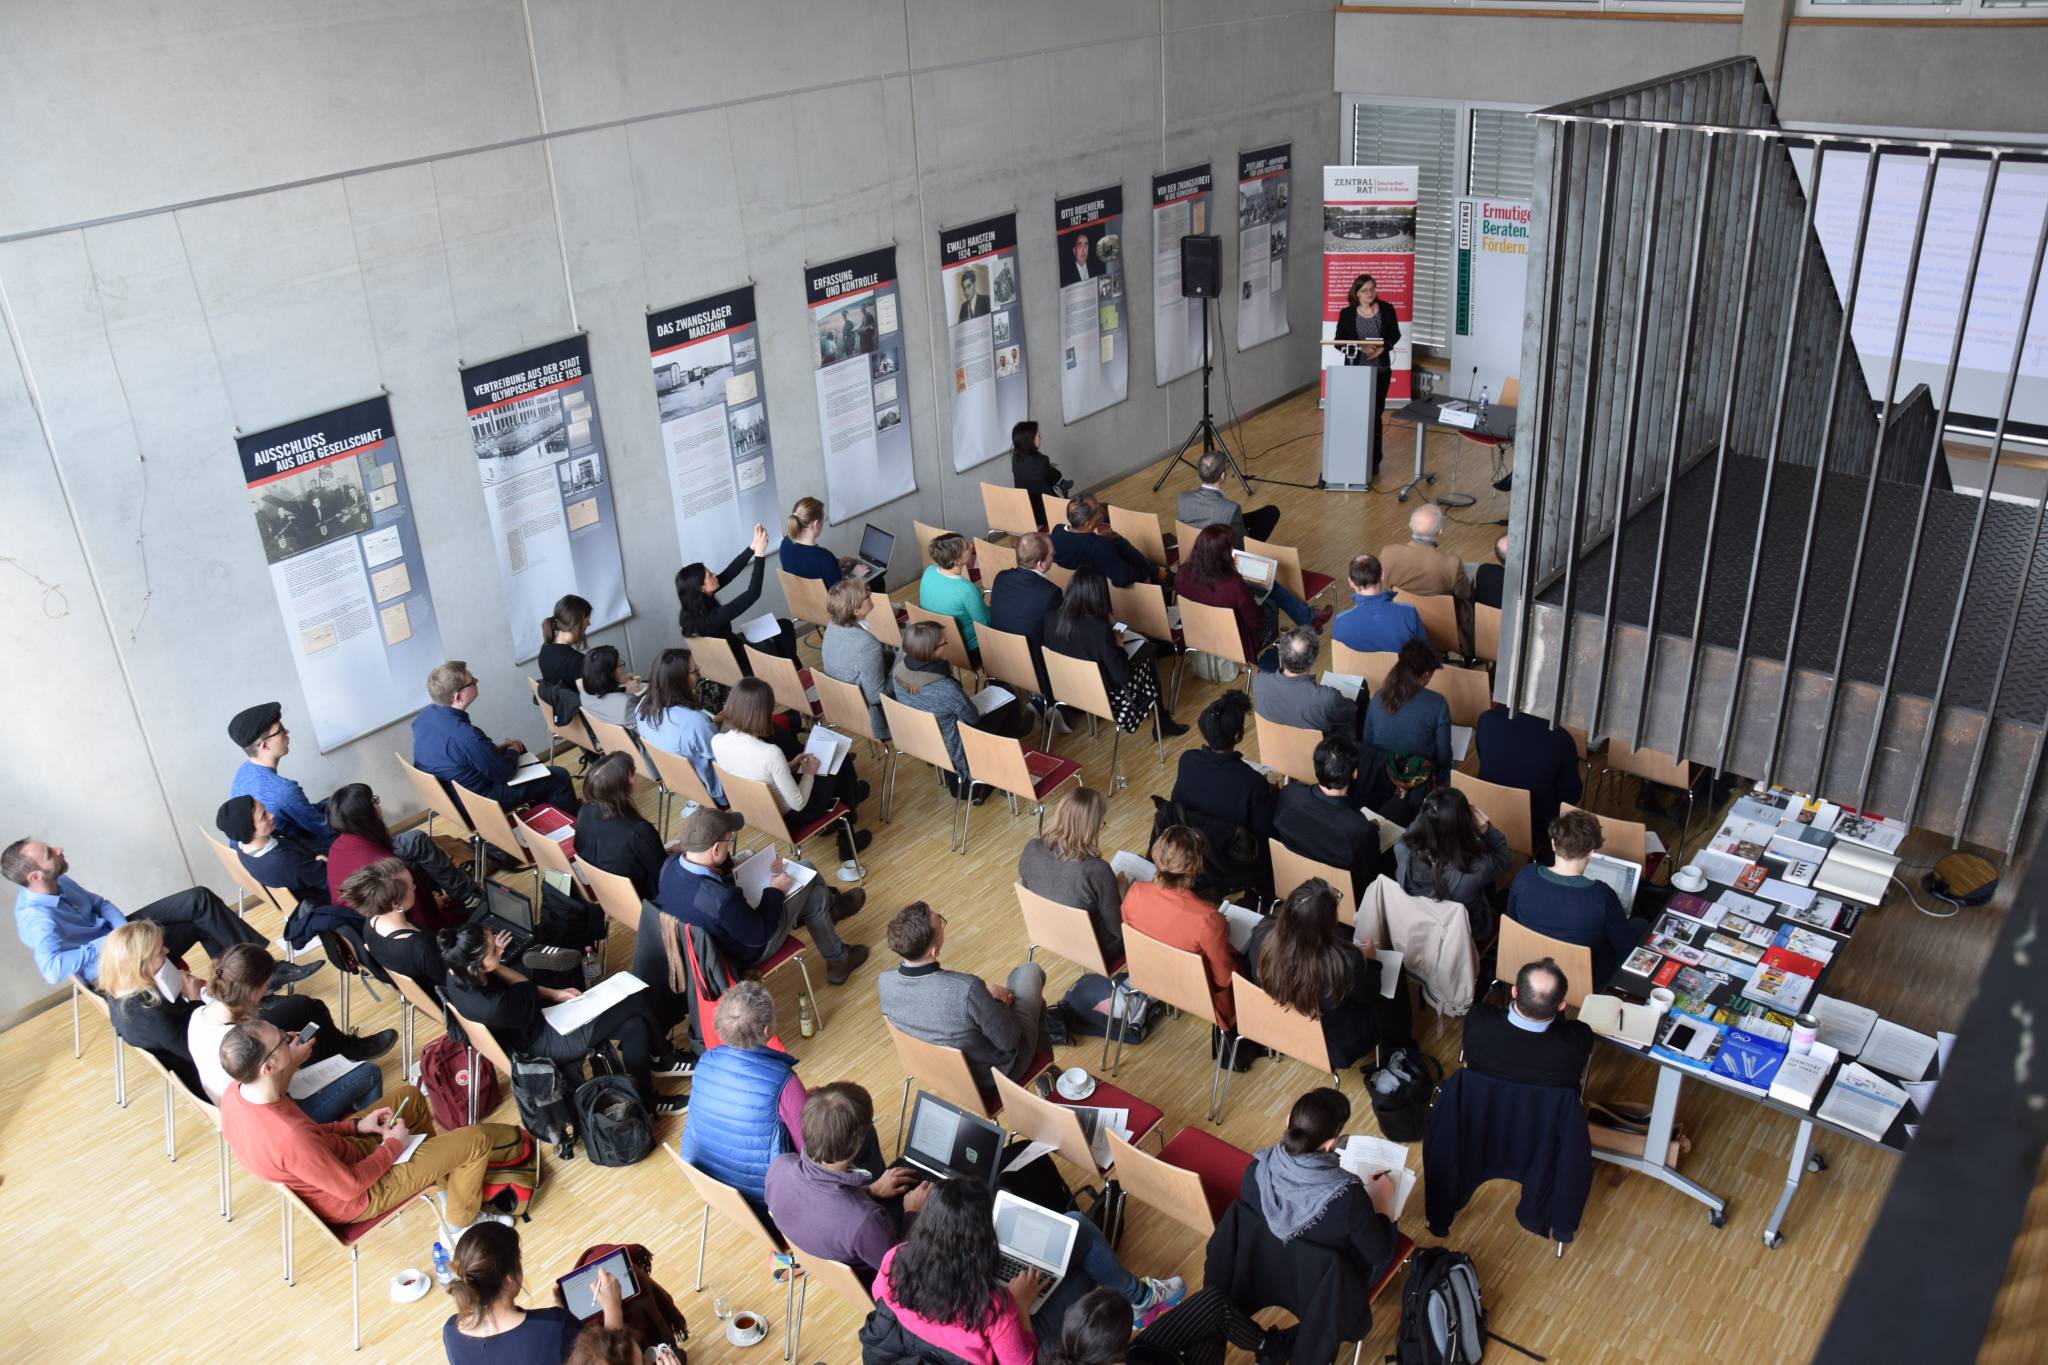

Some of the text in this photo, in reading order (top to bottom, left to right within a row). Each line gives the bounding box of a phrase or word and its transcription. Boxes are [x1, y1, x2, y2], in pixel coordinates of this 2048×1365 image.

[1167, 183, 1176, 193] DER
[1334, 178, 1374, 186] ZENTRAL
[1357, 186, 1373, 194] RAT
[1061, 199, 1104, 220] OTTO ROSENBERG
[1461, 205, 1469, 247] STIFTUNG
[1482, 220, 1530, 238] Beraten.
[946, 231, 996, 253] EWALD HANSTEIN
[958, 248, 971, 260] 1924
[977, 242, 992, 255] 2009
[1481, 236, 1528, 256] Fördern.
[813, 269, 853, 291] ERFASSUNG
[825, 273, 879, 298] UND KONTROLLE
[656, 305, 732, 337] DAS ZWANGSLAGER
[688, 319, 726, 340] MARZAHN
[473, 356, 580, 396] VERTREIBUNG AUS DER STADT
[491, 366, 582, 402] OLYMPISCHE SPIELE 1936
[254, 432, 327, 466] AUSSCHLUSS
[276, 428, 383, 472] AUS DER GESELLSCHAFT
